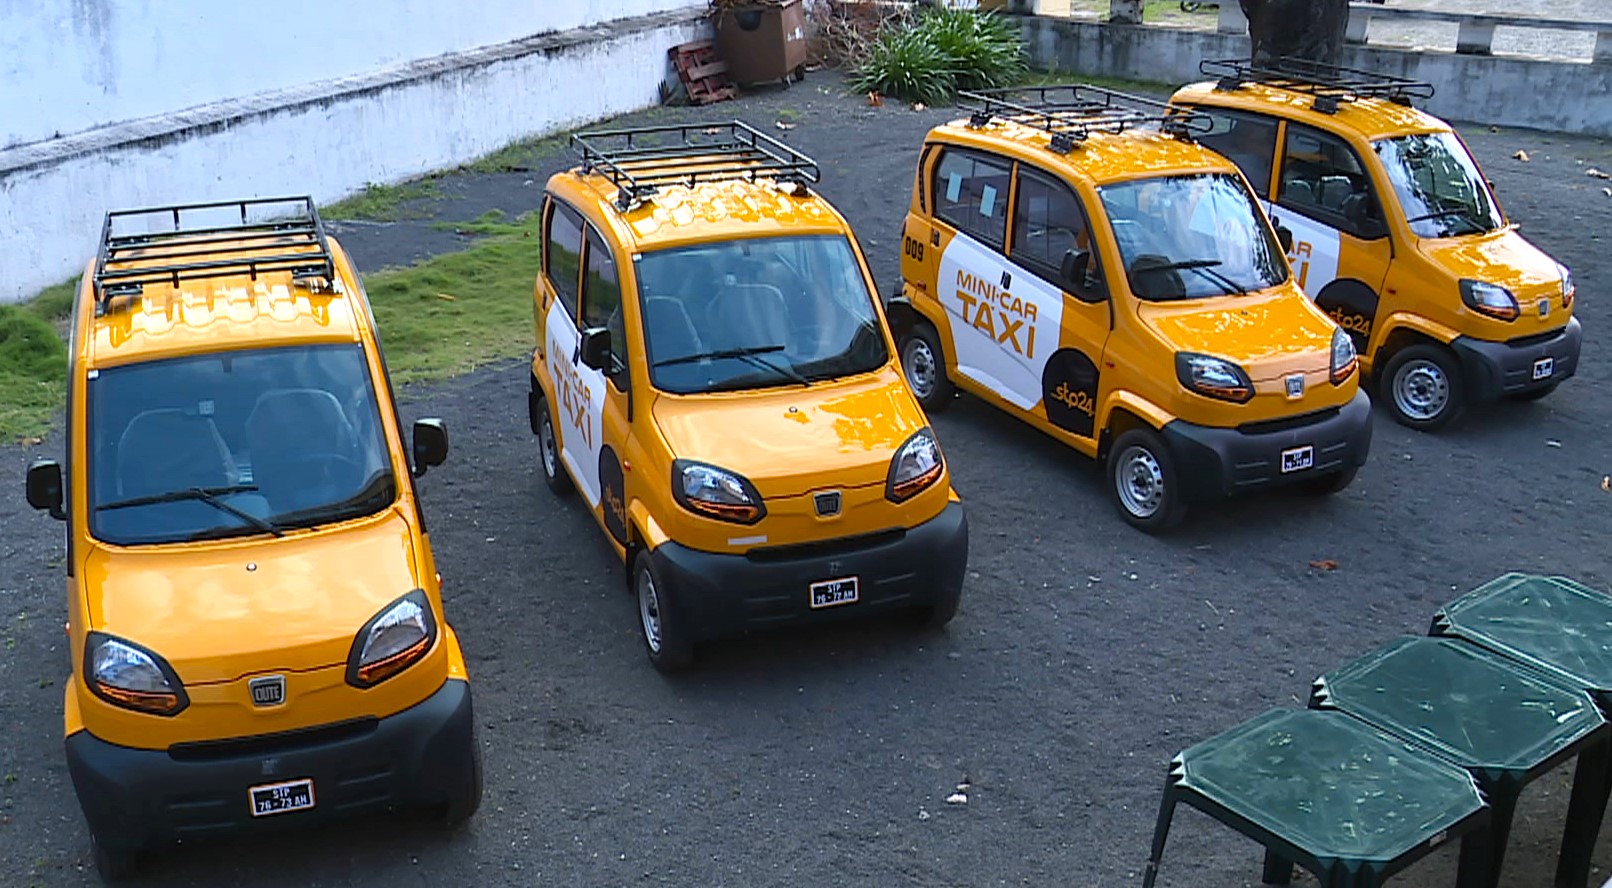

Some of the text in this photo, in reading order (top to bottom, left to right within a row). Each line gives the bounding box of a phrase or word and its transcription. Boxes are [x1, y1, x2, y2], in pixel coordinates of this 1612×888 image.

[905, 236, 924, 262] 009
[956, 290, 1036, 360] TAXI
[553, 362, 592, 451] TAXI
[272, 786, 290, 799] STP
